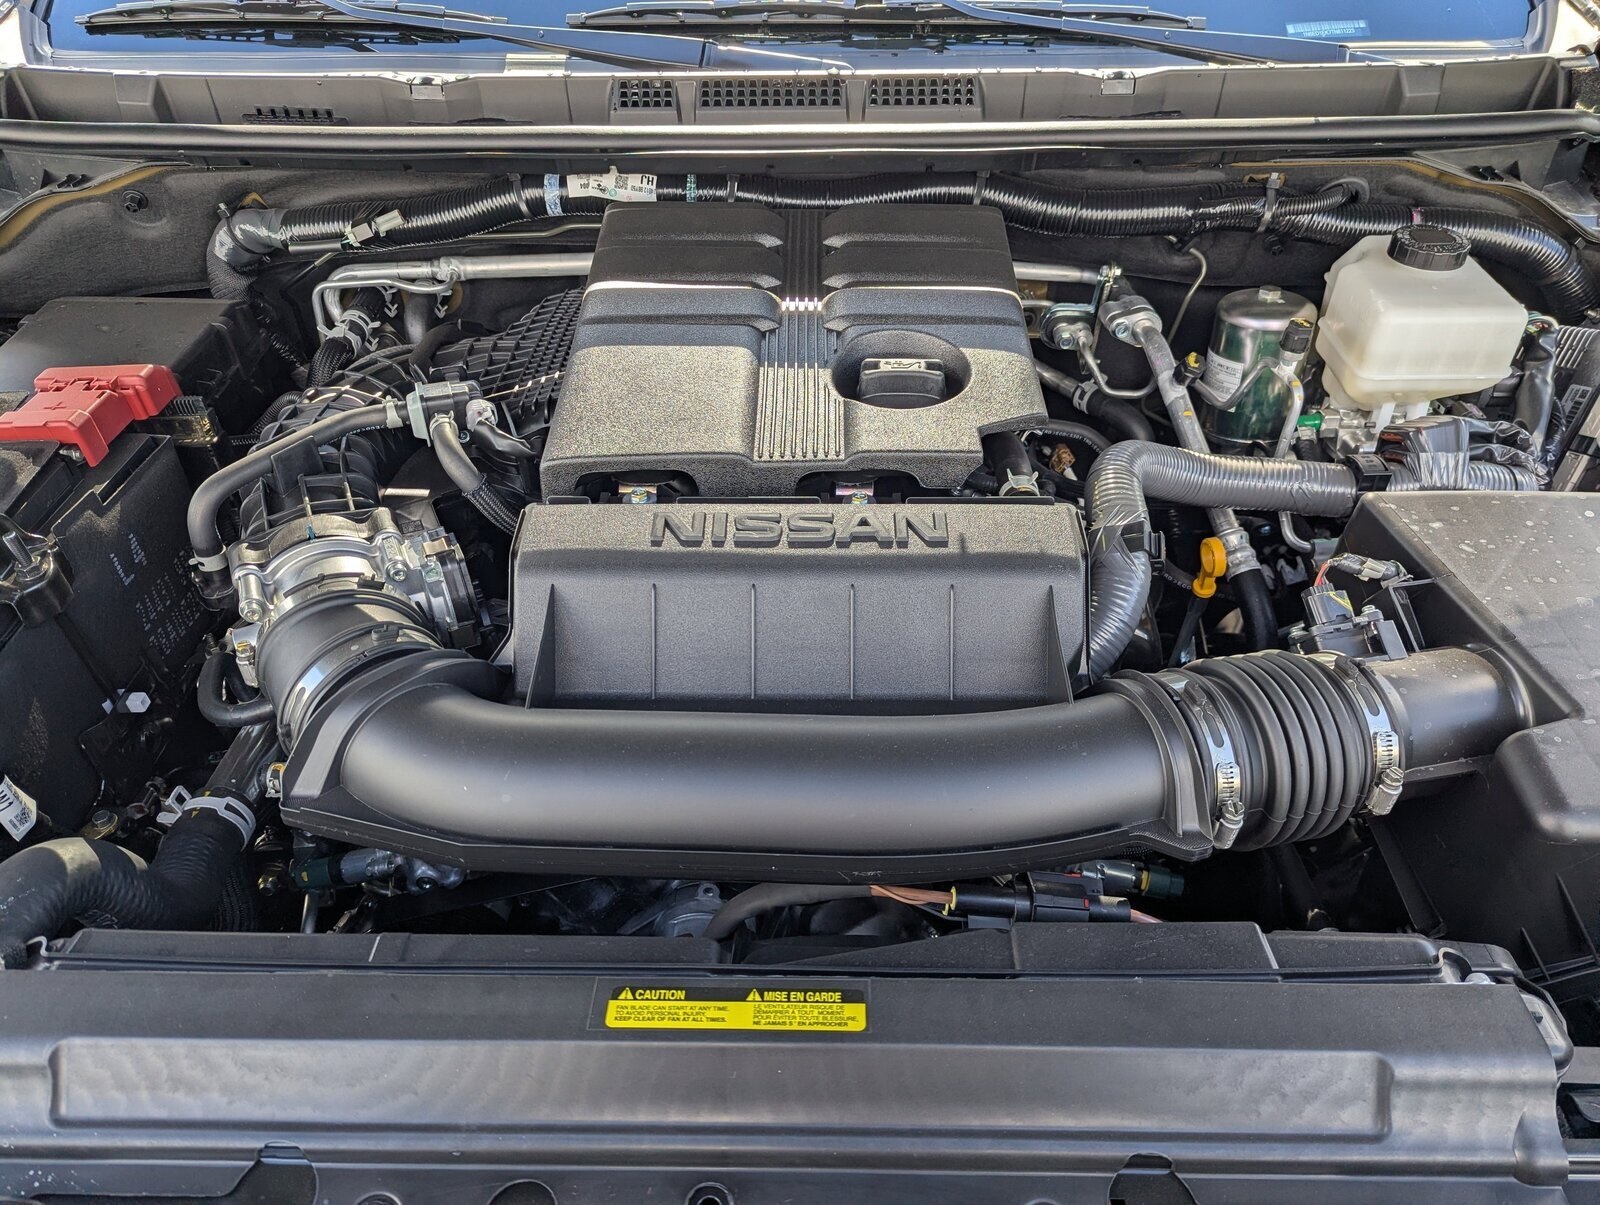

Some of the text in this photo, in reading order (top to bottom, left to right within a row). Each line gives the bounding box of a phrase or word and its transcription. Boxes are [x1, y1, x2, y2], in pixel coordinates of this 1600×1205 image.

[640, 174, 654, 186] HJ
[650, 511, 949, 548] NISSAN
[635, 989, 686, 1000] CAUTION
[763, 991, 842, 1002] MISE EN GARDE
